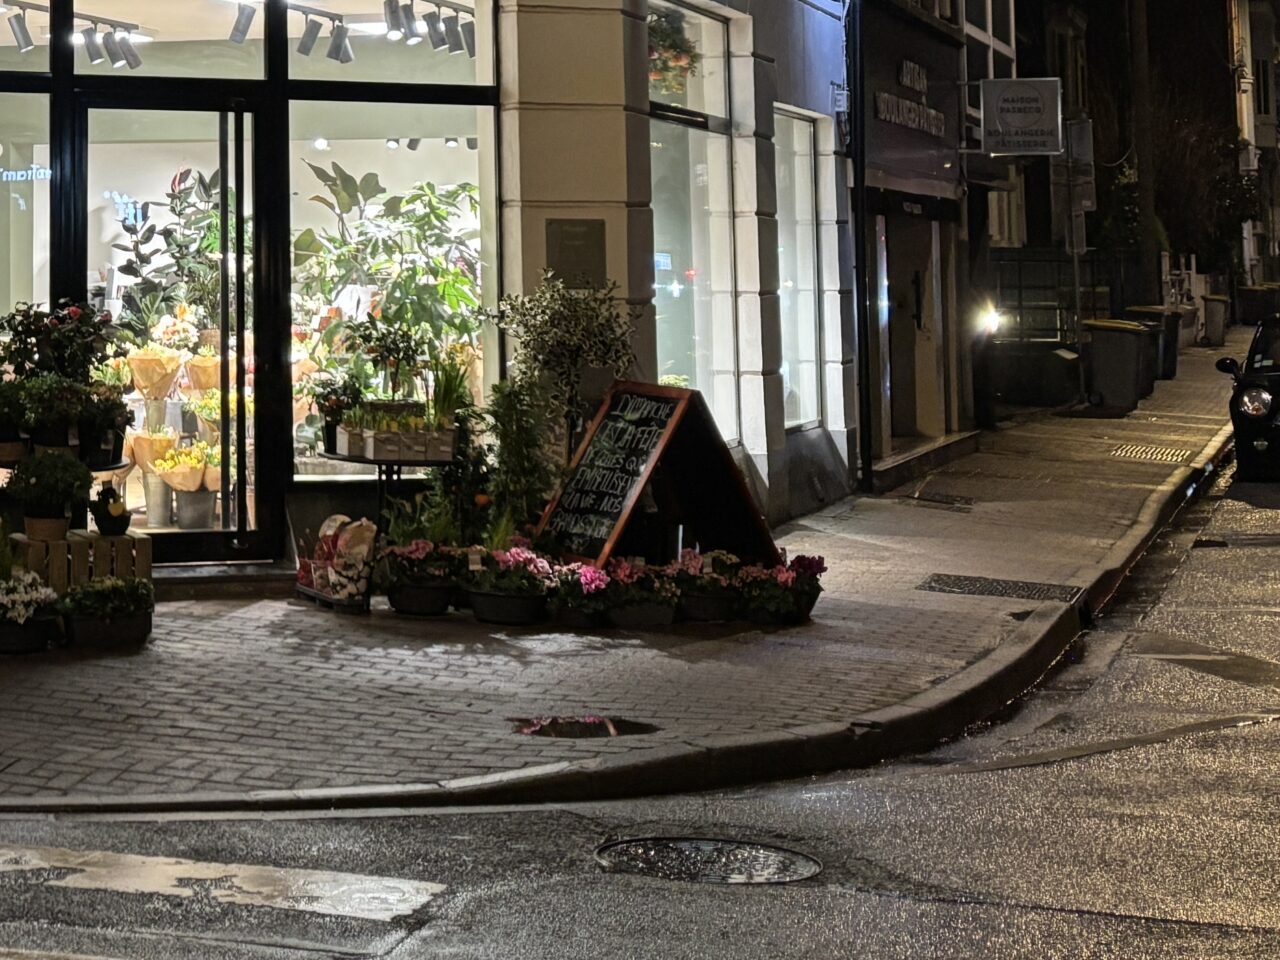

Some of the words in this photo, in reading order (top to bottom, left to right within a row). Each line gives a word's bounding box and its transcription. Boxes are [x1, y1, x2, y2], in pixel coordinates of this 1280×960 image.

[1002, 96, 1039, 104] MAISON
[987, 128, 1055, 137] BOULANGERIE
[600, 496, 622, 512] NOS
